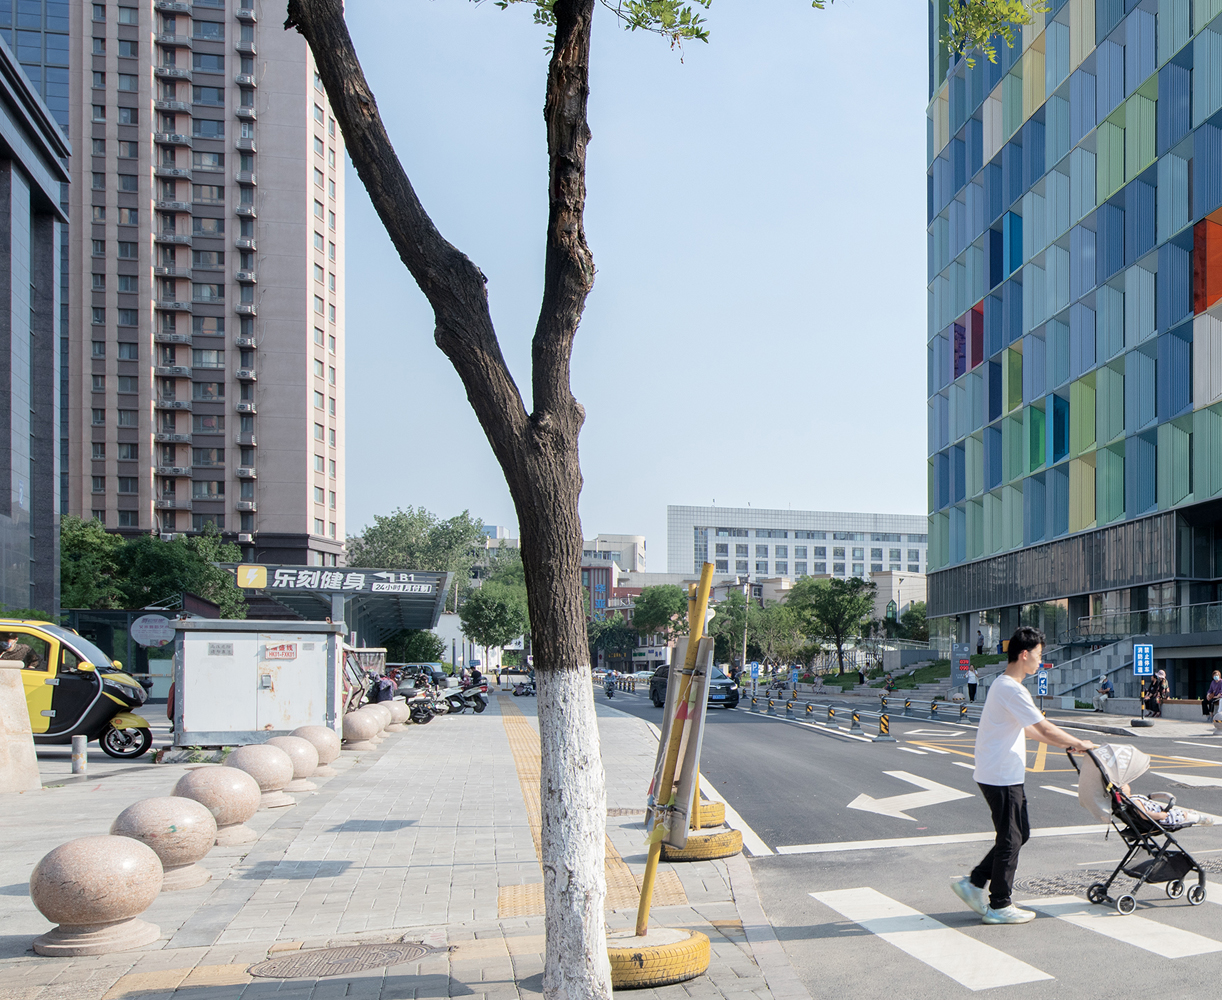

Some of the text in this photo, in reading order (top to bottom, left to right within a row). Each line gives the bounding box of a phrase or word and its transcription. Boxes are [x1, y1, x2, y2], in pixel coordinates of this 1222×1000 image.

[272, 569, 365, 590] 乐刻健身
[400, 573, 415, 582] B1
